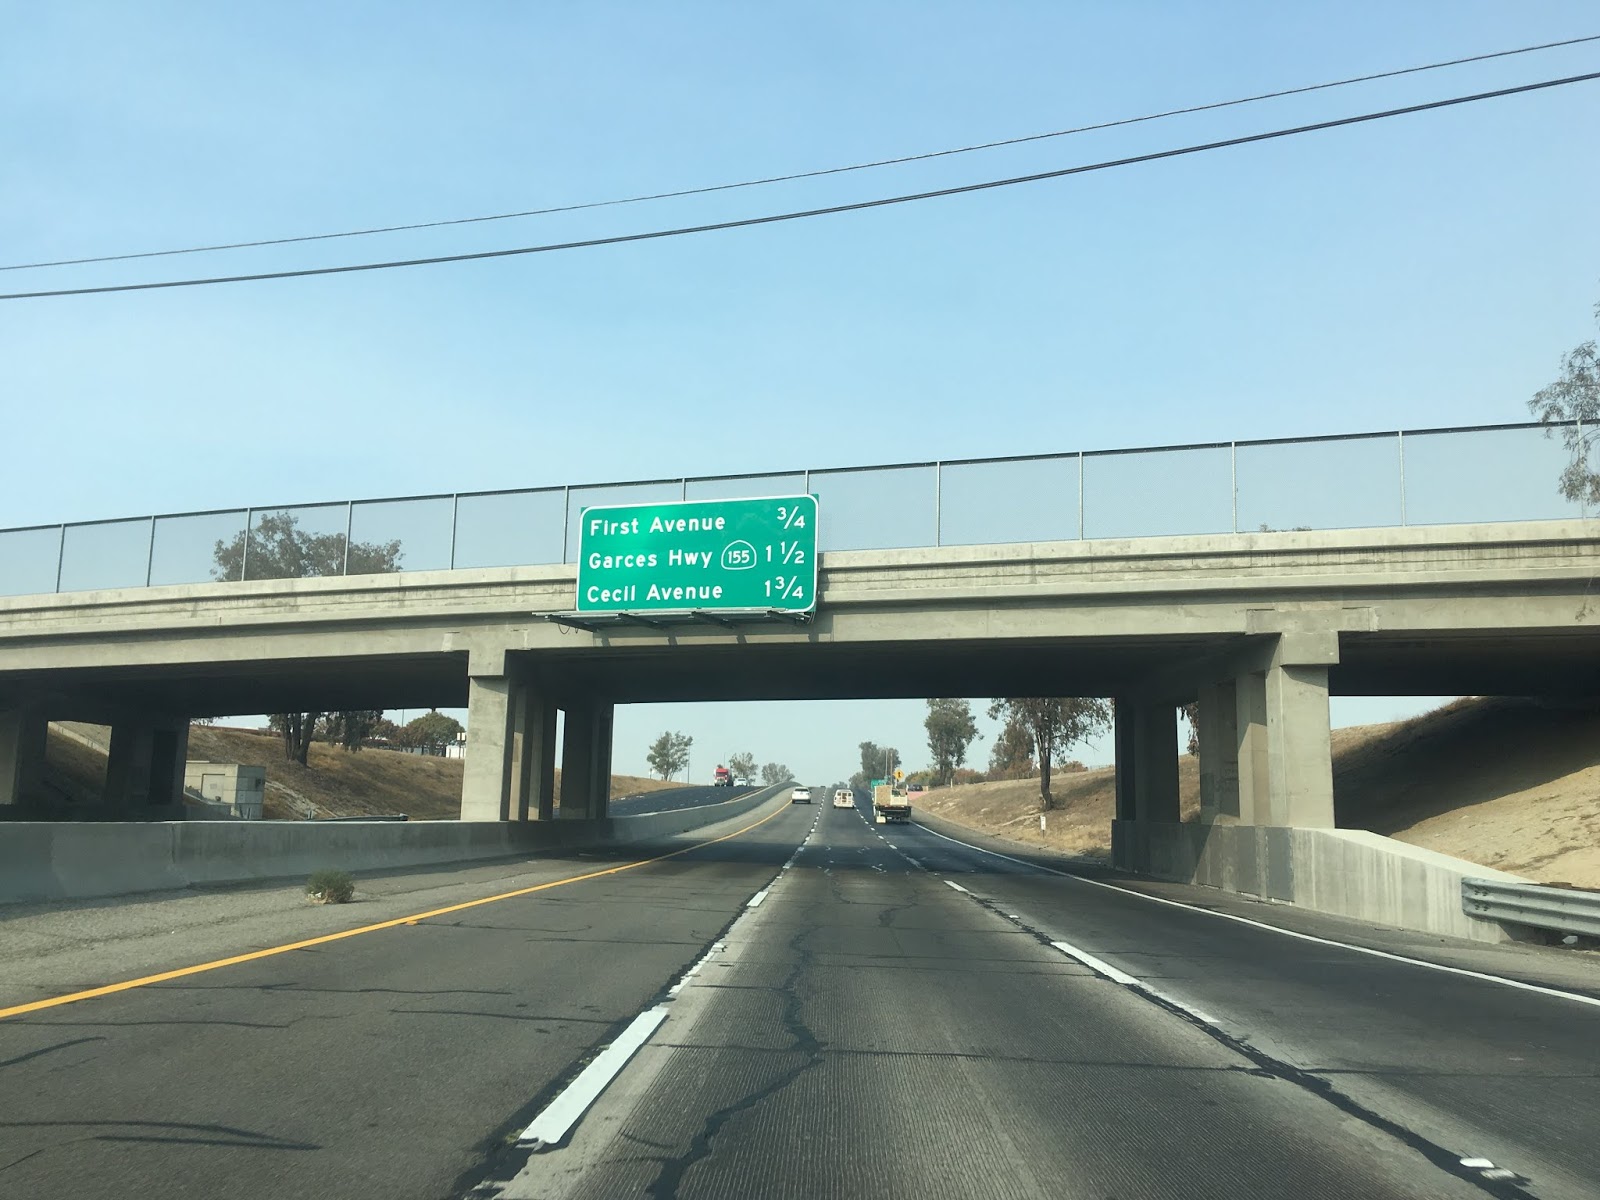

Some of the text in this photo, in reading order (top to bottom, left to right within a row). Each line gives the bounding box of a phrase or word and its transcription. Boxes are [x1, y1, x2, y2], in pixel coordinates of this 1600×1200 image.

[590, 518, 639, 536] First
[649, 516, 726, 533] Avenue
[588, 553, 658, 570] Garces
[668, 549, 713, 569] Hwy
[727, 549, 751, 565] 155
[587, 584, 637, 603] Cecil
[646, 583, 723, 600] Avenue
